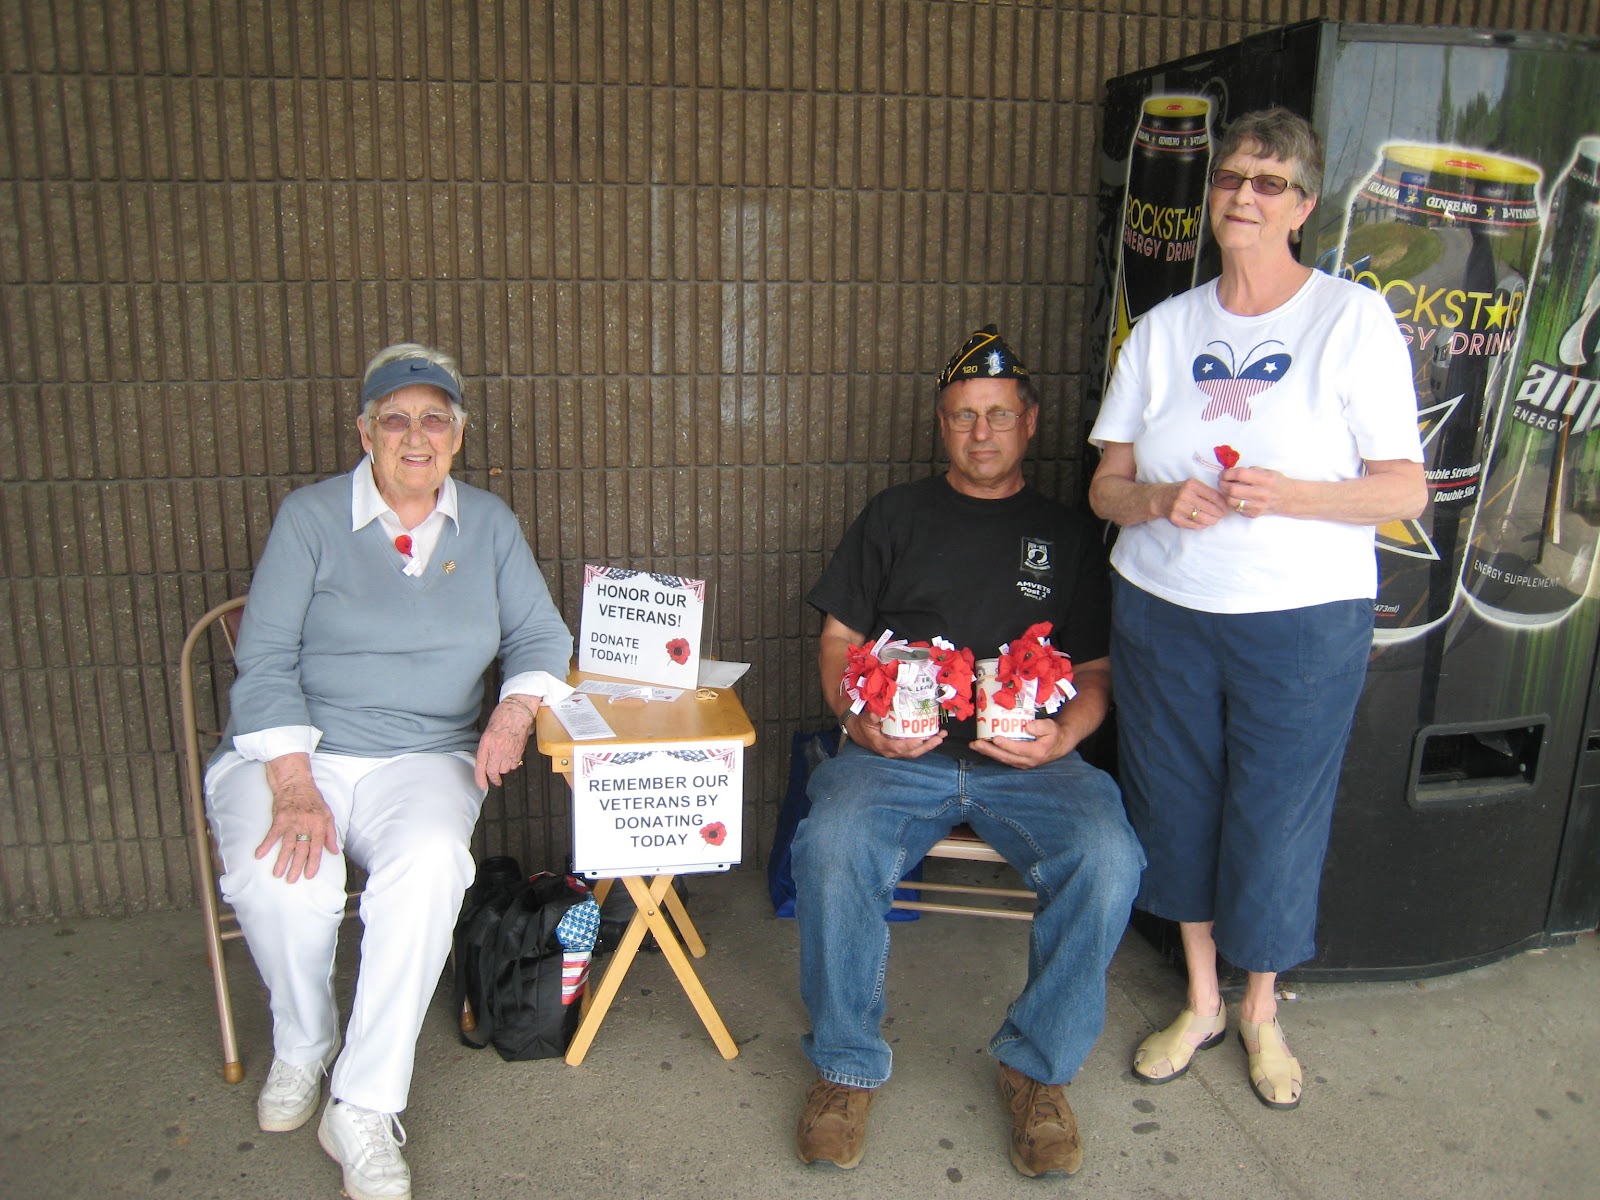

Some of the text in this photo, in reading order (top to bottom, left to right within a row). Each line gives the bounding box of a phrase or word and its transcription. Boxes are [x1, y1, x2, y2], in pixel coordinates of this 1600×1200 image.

[1426, 196, 1477, 215] GINSENG
[1123, 224, 1197, 262] ENERGY DRINK
[1449, 331, 1516, 356] DRINK
[962, 365, 978, 374] 120
[1513, 405, 1568, 432] ENERGY
[1424, 469, 1451, 480] ouble
[1433, 489, 1464, 503] Double
[1474, 559, 1561, 588] ENERGY SUPPLEMENT
[597, 583, 687, 608] HONOR OUR
[1016, 581, 1052, 594] AMVETS
[599, 603, 682, 628] VETERANS!
[590, 632, 640, 650] DONATE
[590, 647, 638, 666] TODAY!!
[991, 718, 1031, 733] POPP
[589, 774, 729, 792] REMEMBER OUR
[599, 794, 719, 811] VETERANS BY
[615, 814, 703, 830] DONATING
[630, 833, 688, 848] TODAY
